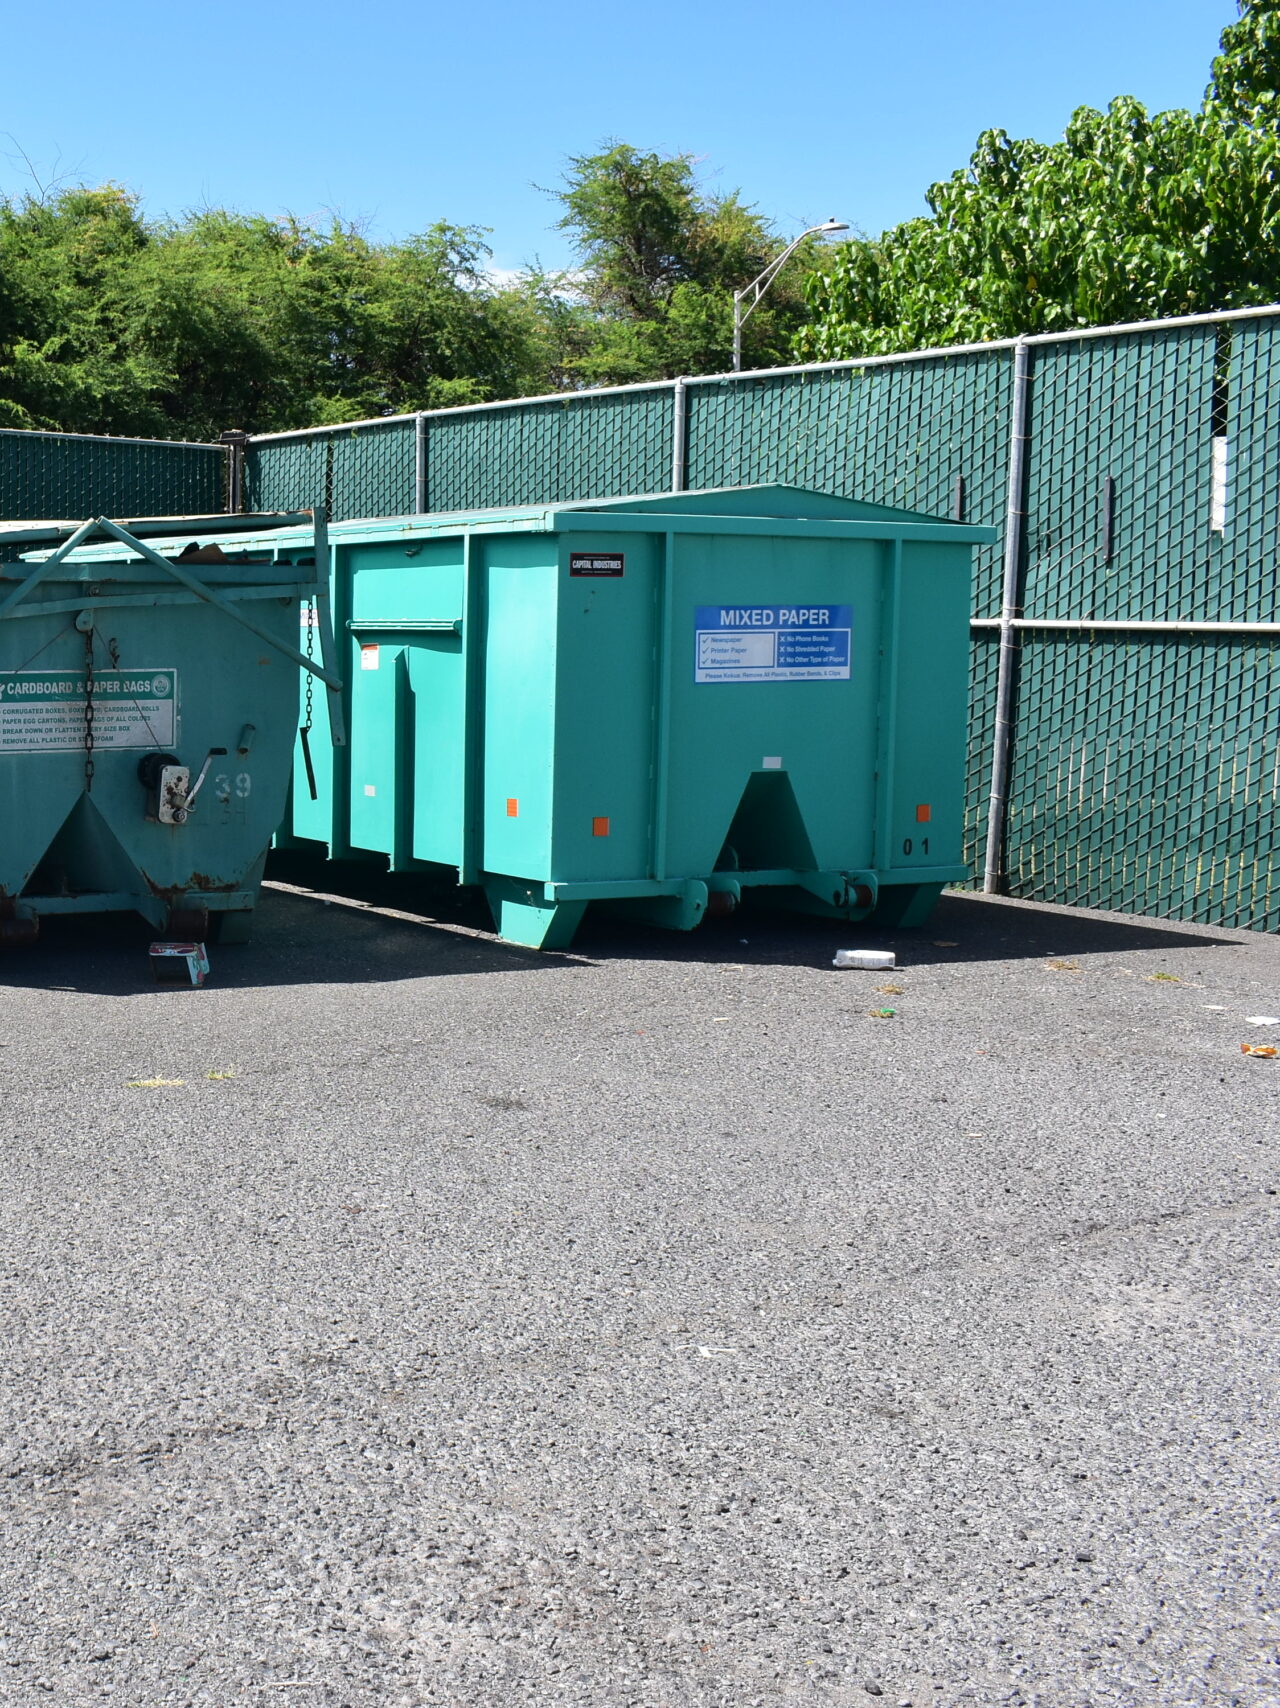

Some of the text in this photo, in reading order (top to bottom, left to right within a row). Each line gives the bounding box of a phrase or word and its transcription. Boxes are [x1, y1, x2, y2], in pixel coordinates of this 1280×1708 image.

[572, 560, 621, 568] CAPITAL INDUSTRIES
[720, 609, 829, 625] MIXED PAPER
[7, 682, 72, 694] CARDBOARD
[76, 682, 84, 693] &
[87, 681, 120, 693] PAPER
[123, 680, 150, 692] BAGS
[216, 773, 251, 797] 39
